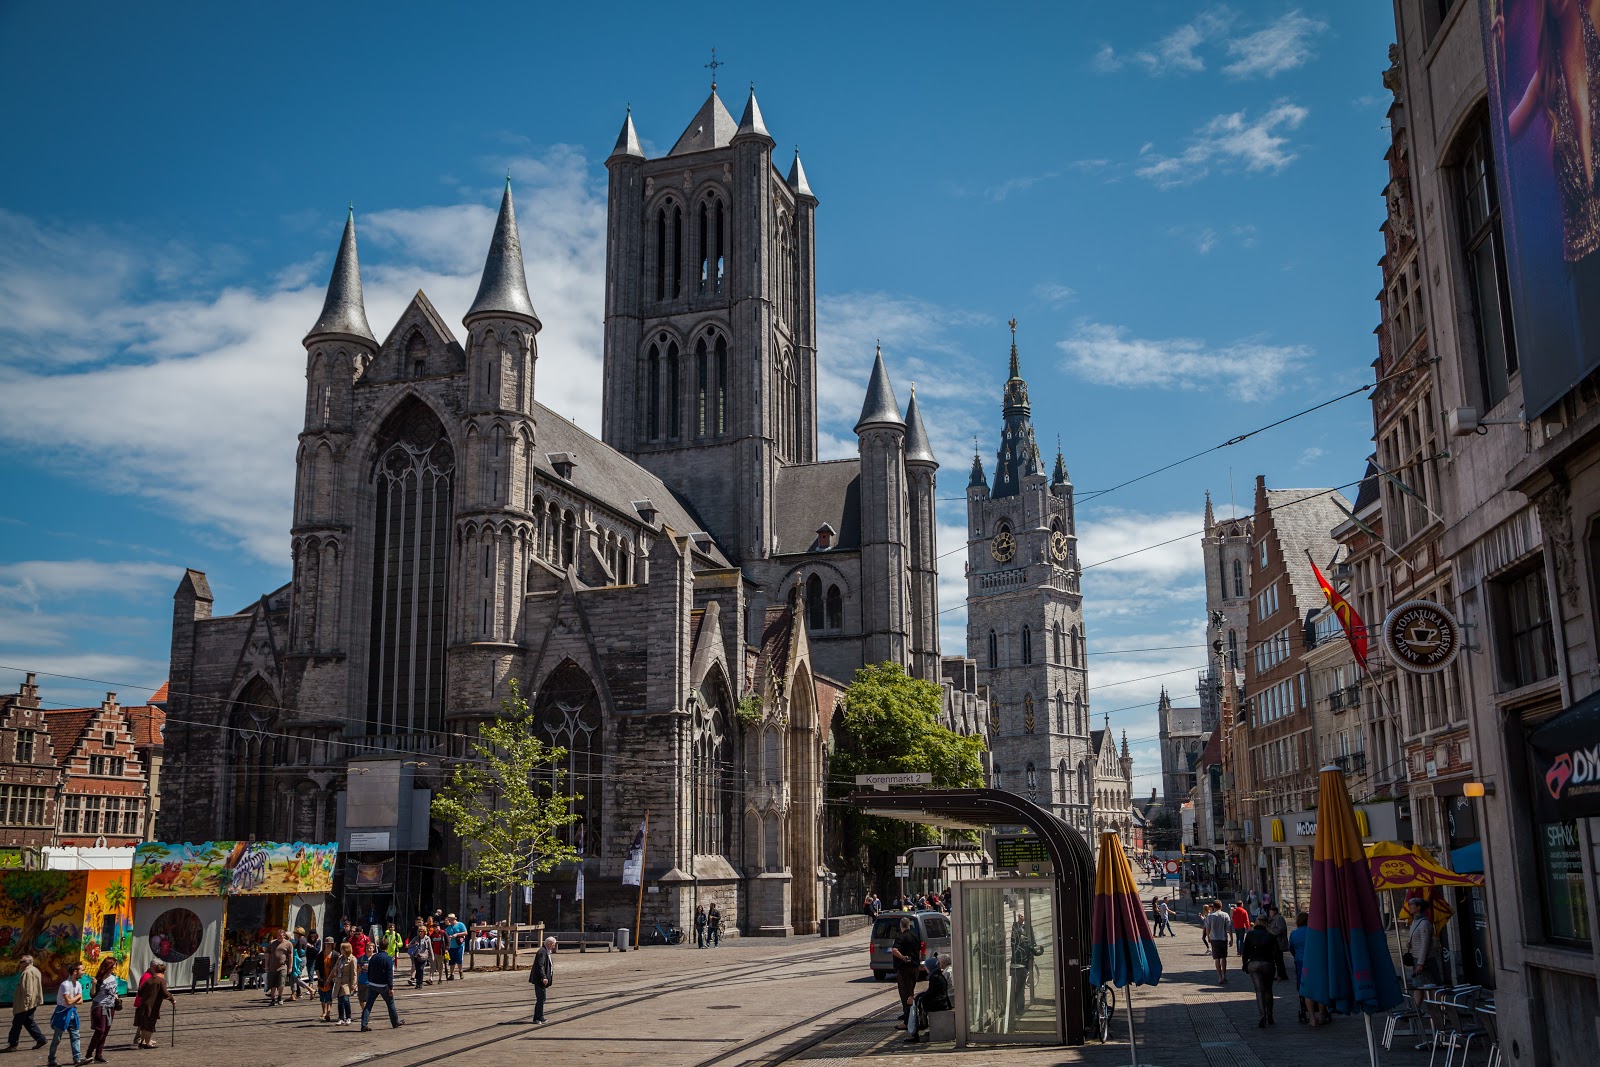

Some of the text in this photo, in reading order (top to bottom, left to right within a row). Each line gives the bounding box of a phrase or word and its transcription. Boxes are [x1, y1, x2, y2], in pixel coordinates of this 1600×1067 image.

[1395, 609, 1451, 662] ANTICA TOSTATURA TRIESTINA
[866, 774, 921, 784] Korenmarkt 2
[1296, 821, 1317, 836] McDon
